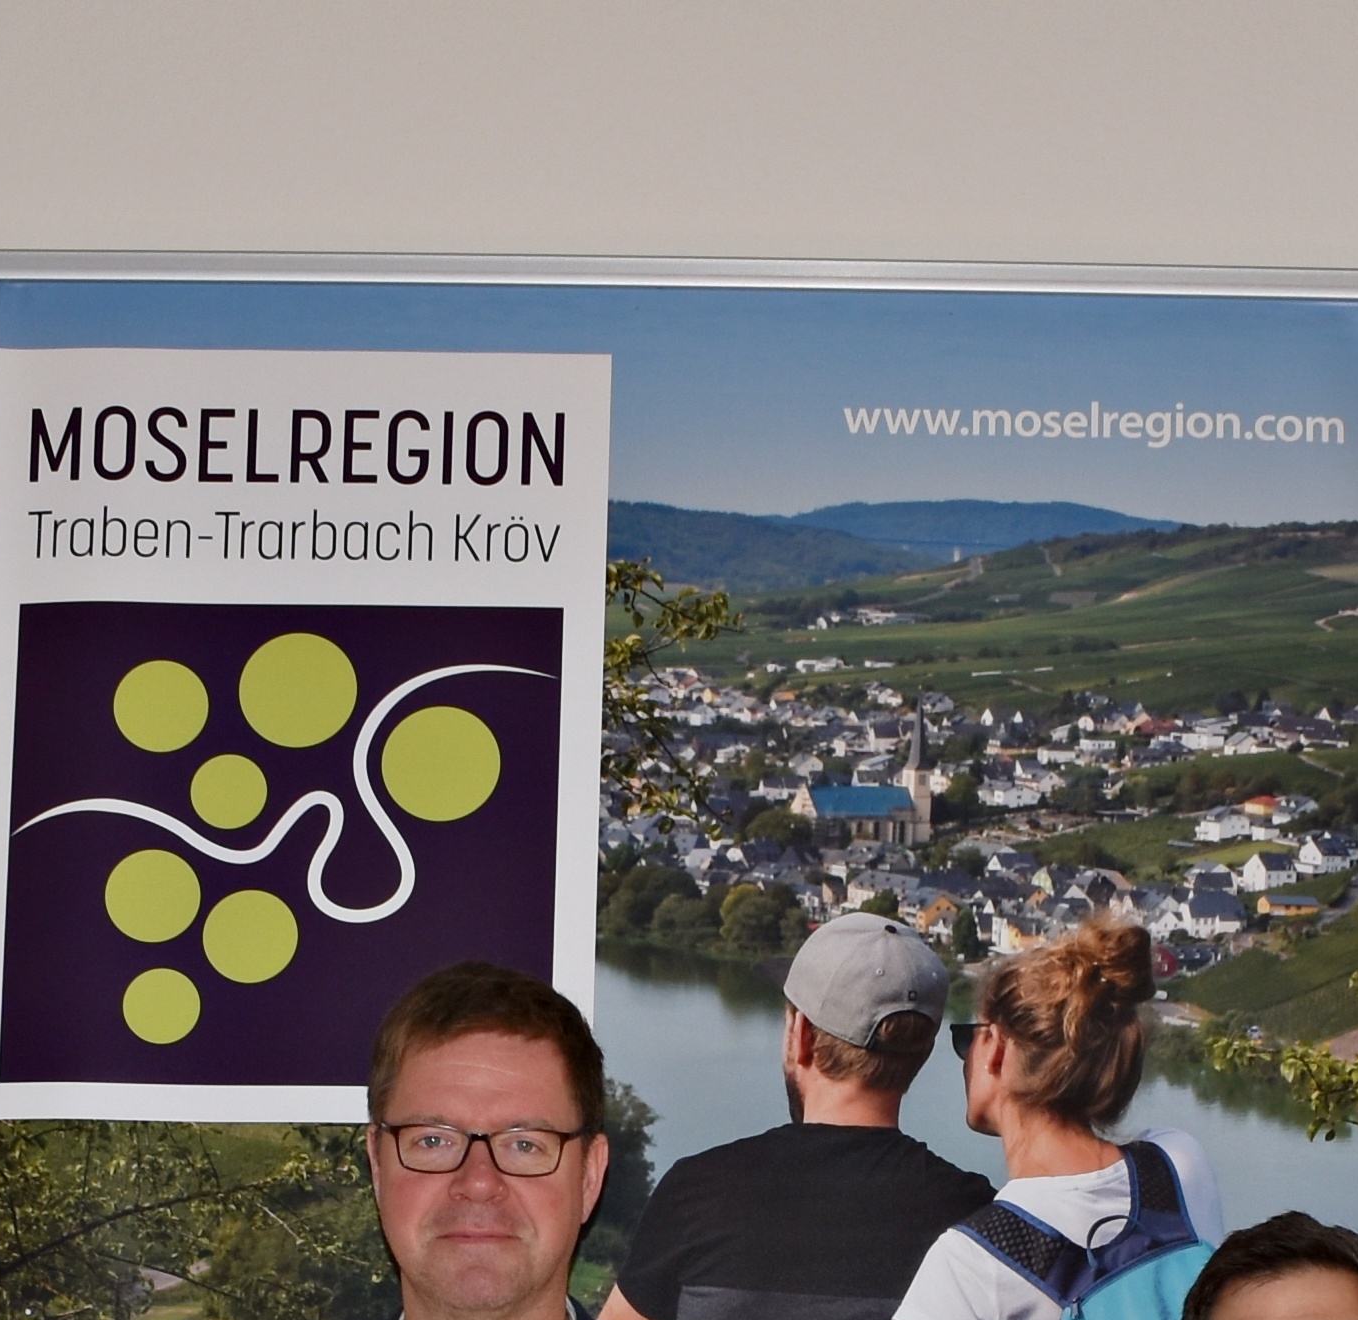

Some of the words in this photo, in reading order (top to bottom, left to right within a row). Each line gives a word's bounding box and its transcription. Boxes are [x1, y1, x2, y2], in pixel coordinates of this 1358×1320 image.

[29, 405, 566, 487] MOSELREGION
[843, 401, 1345, 448] www.moselregion.com
[28, 506, 435, 561] Traben-Trarbach
[454, 512, 561, 564] Kröv
